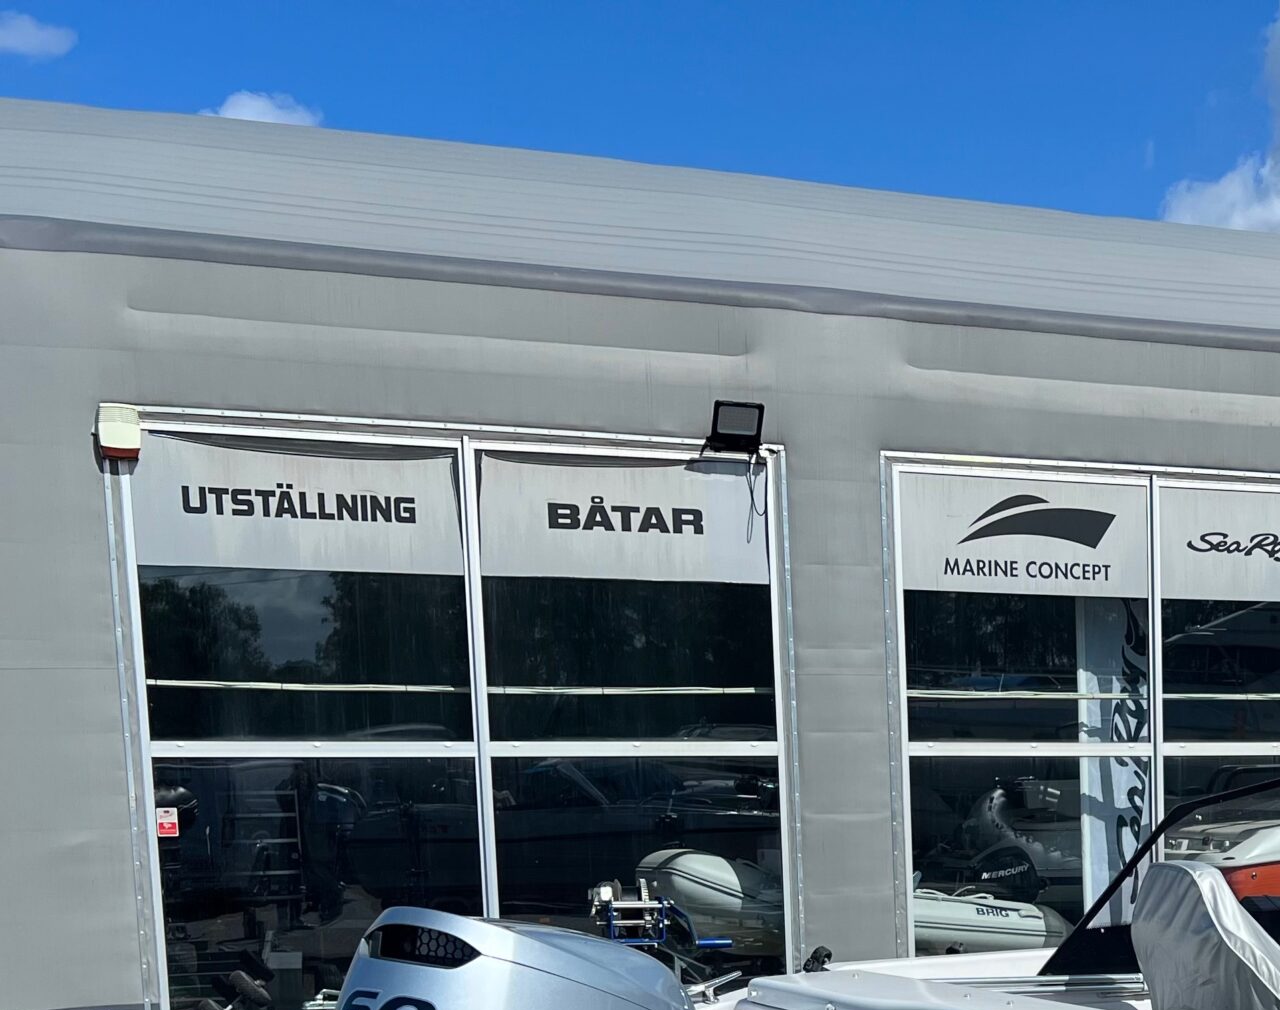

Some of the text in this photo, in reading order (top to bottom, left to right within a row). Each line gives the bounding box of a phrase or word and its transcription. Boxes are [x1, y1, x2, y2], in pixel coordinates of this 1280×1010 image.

[181, 483, 416, 524] UTSTÄLLNING
[547, 495, 704, 535] BÅTAR
[1187, 531, 1247, 554] Sea
[944, 557, 1111, 582] MARINE CONCEPT
[981, 861, 1030, 880] MERCURY
[976, 907, 1010, 918] BRIG
